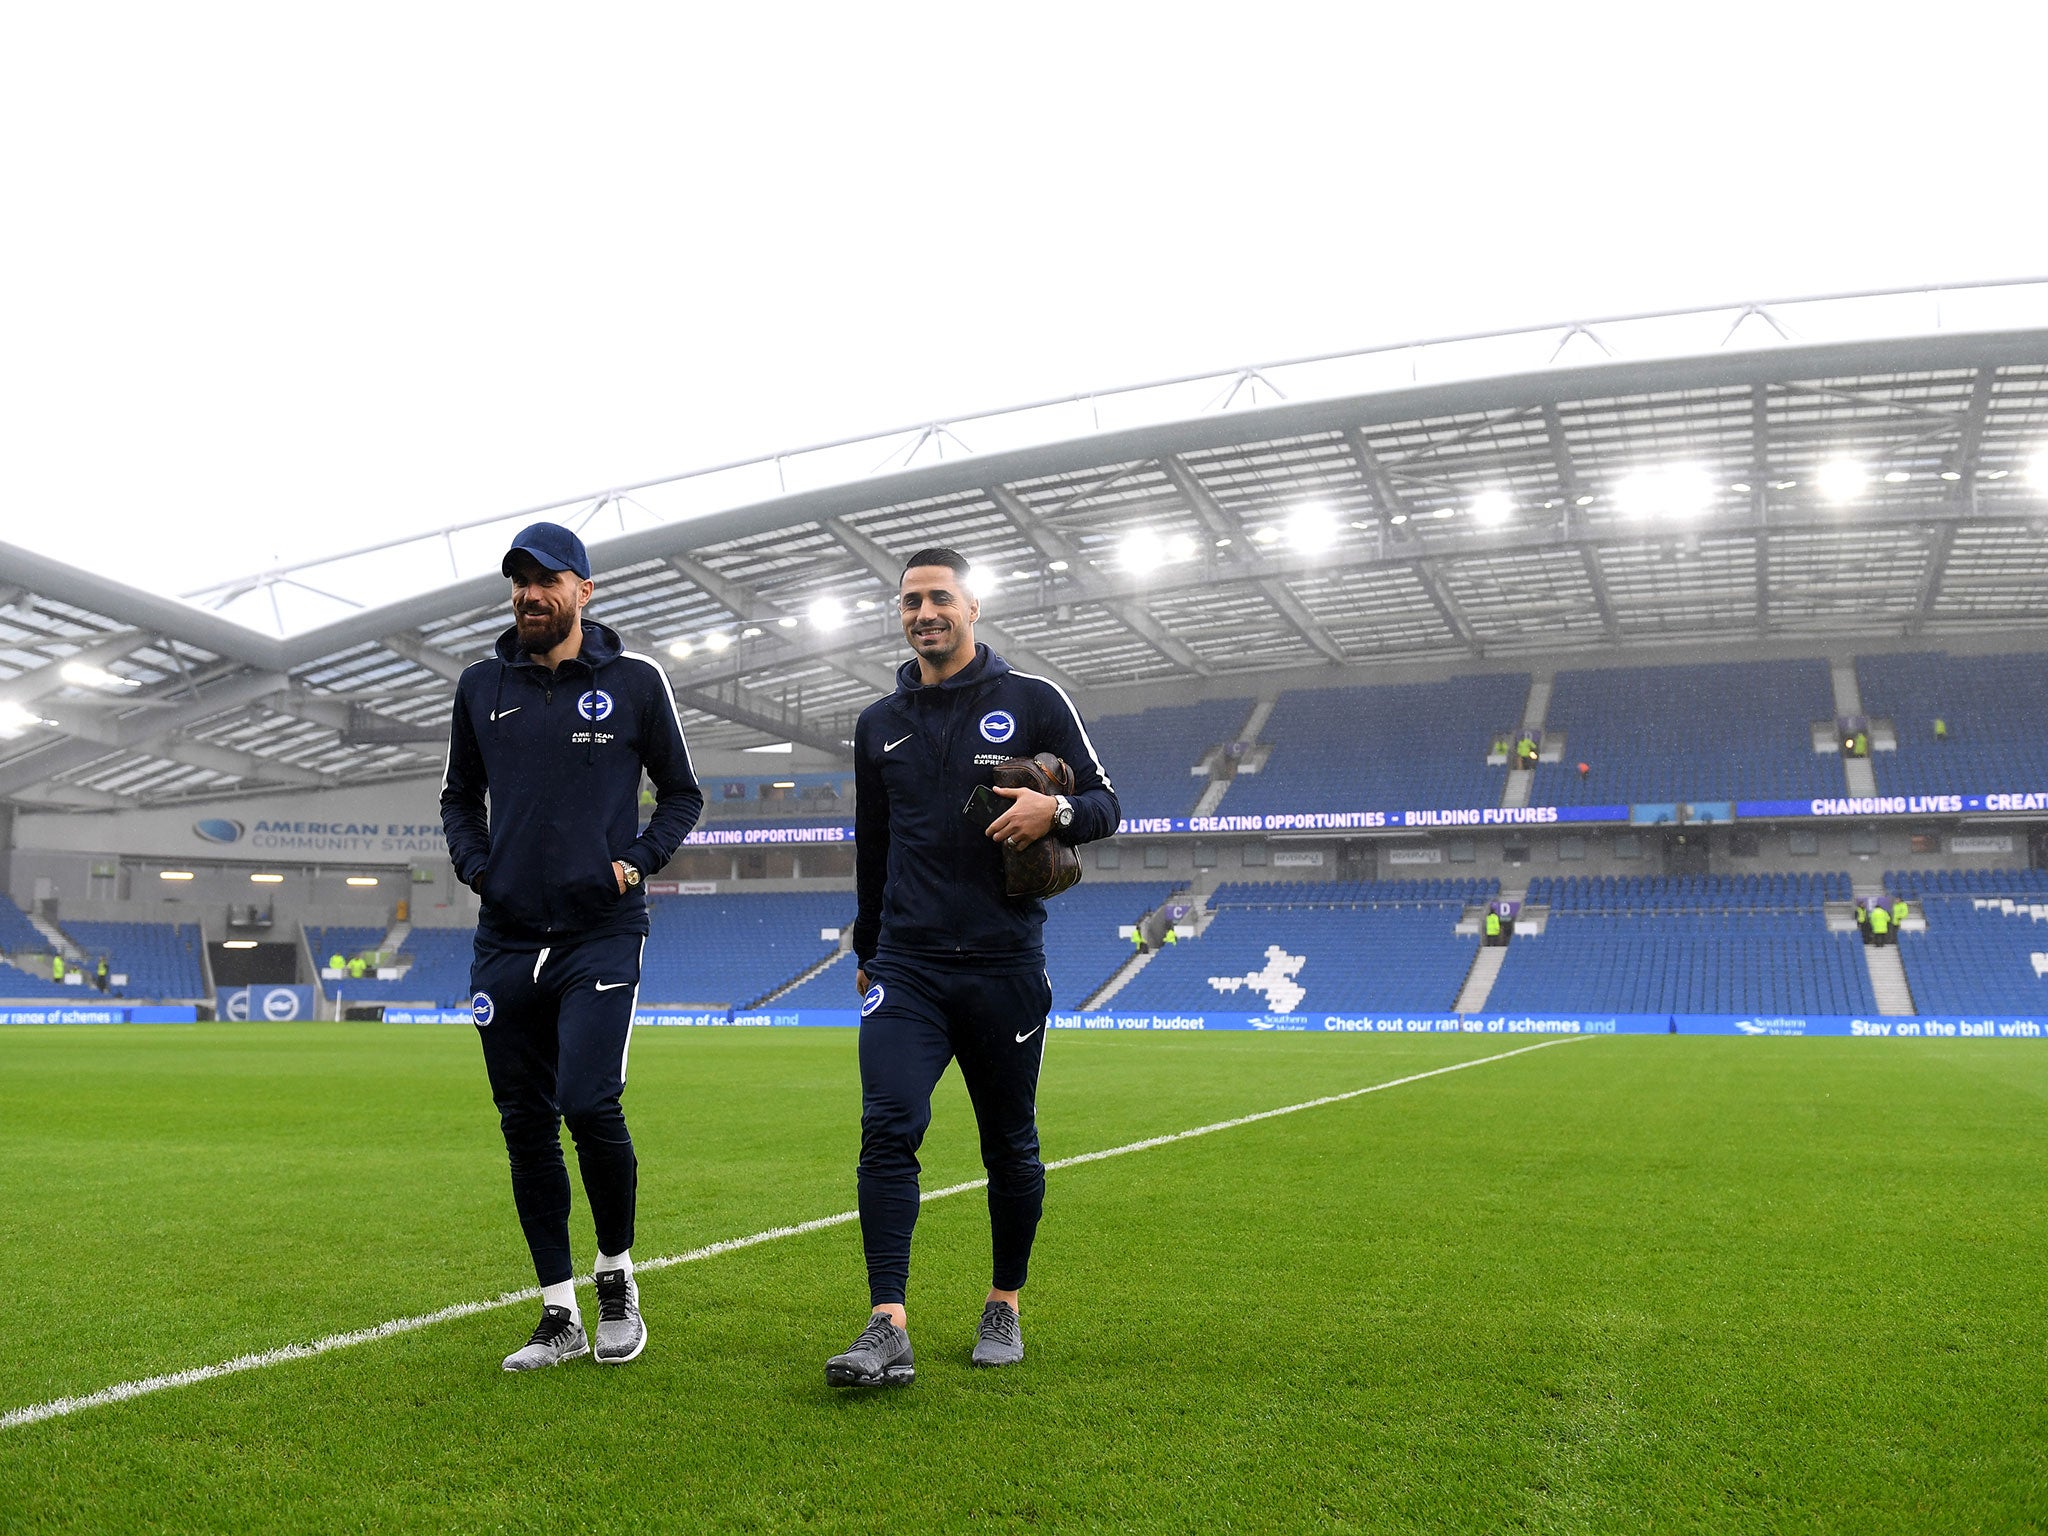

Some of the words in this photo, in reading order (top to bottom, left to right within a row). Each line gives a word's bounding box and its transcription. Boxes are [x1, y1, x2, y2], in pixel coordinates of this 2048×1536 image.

[572, 732, 614, 740] AMEICAN
[1811, 797, 1906, 815] CHANGING
[1909, 795, 1963, 813] LIVES
[1985, 793, 2048, 810] CREAT
[1130, 818, 1172, 833] LIVES
[1189, 815, 1262, 831] CREATING
[1264, 812, 1386, 830] OPPORTUNITIES
[1405, 809, 1480, 826] BUILDING
[1483, 807, 1558, 824] FUTURES
[254, 820, 378, 836] AMERICAN
[387, 824, 445, 837] EXPR
[682, 830, 742, 844] CREATING
[744, 827, 844, 843] OPPORTUNITIES
[252, 835, 372, 850] COMMUNITY
[1173, 906, 1183, 918] C
[1500, 902, 1511, 916] D
[47, 1010, 61, 1024] of
[62, 1010, 111, 1024] schemes
[388, 1012, 412, 1024] with
[635, 1017, 654, 1026] our
[695, 1014, 710, 1026] of
[712, 1015, 771, 1026] scemes
[774, 1014, 799, 1026] and
[1055, 1015, 1081, 1029] ball
[1084, 1016, 1114, 1029] with
[1117, 1018, 1150, 1029] your
[1153, 1015, 1205, 1029] budget
[1324, 1016, 1373, 1032] Check
[1377, 1018, 1403, 1032] out
[1406, 1020, 1432, 1032] our
[1487, 1017, 1505, 1033] of
[1508, 1017, 1581, 1033] schemes
[1585, 1018, 1616, 1033] and
[1851, 1020, 1891, 1037] Stay
[1896, 1023, 1921, 1037] on
[1925, 1020, 1956, 1037] the
[1960, 1020, 1994, 1037] ball
[1998, 1020, 2041, 1037] with
